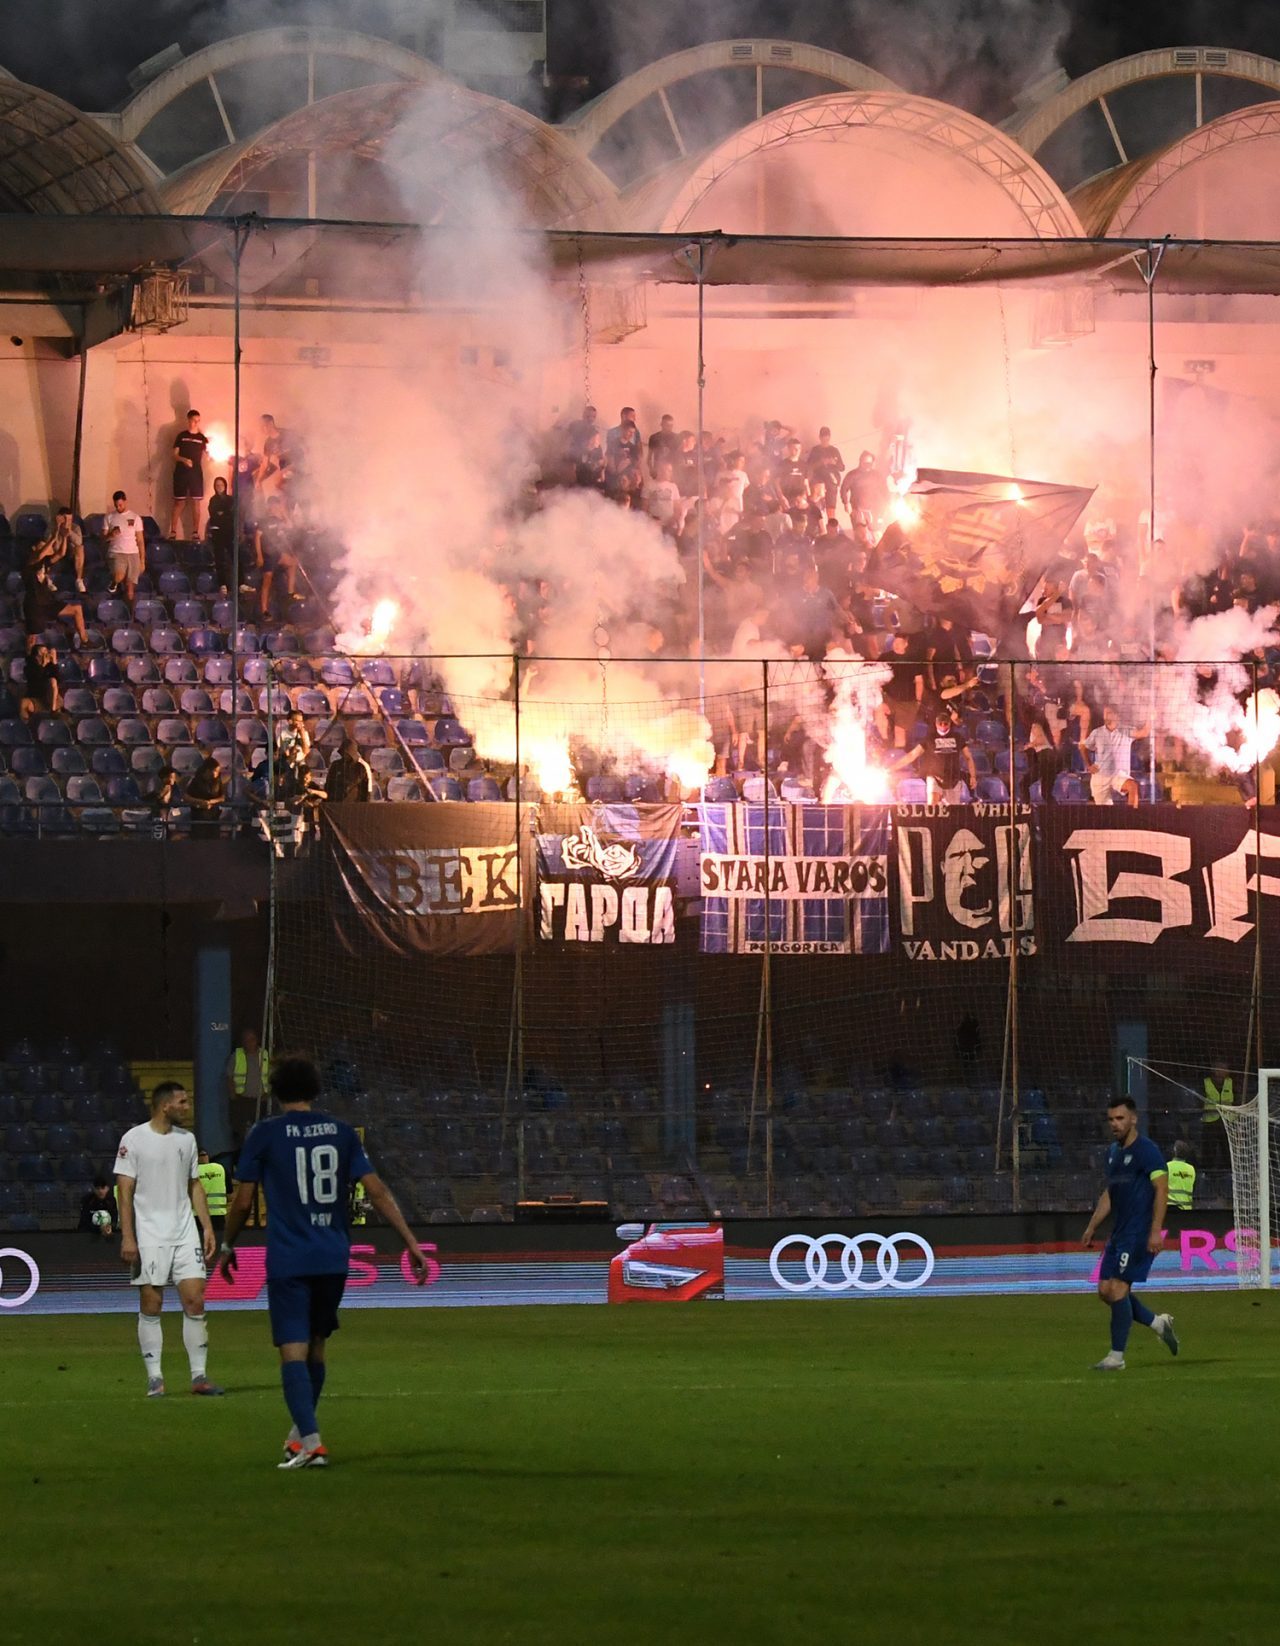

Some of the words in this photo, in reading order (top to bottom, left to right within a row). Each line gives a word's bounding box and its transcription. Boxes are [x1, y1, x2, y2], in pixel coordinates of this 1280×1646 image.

[897, 803, 950, 818] BLUE
[702, 858, 789, 893] STARA
[794, 855, 887, 894] VAROŠ
[540, 882, 676, 944] ГАРДА
[901, 935, 1038, 961] VANDALS
[285, 1124, 301, 1137] FK
[295, 1144, 339, 1205] 18
[400, 1243, 441, 1286] 6
[1118, 1252, 1130, 1267] 9
[1180, 1229, 1261, 1270] RS
